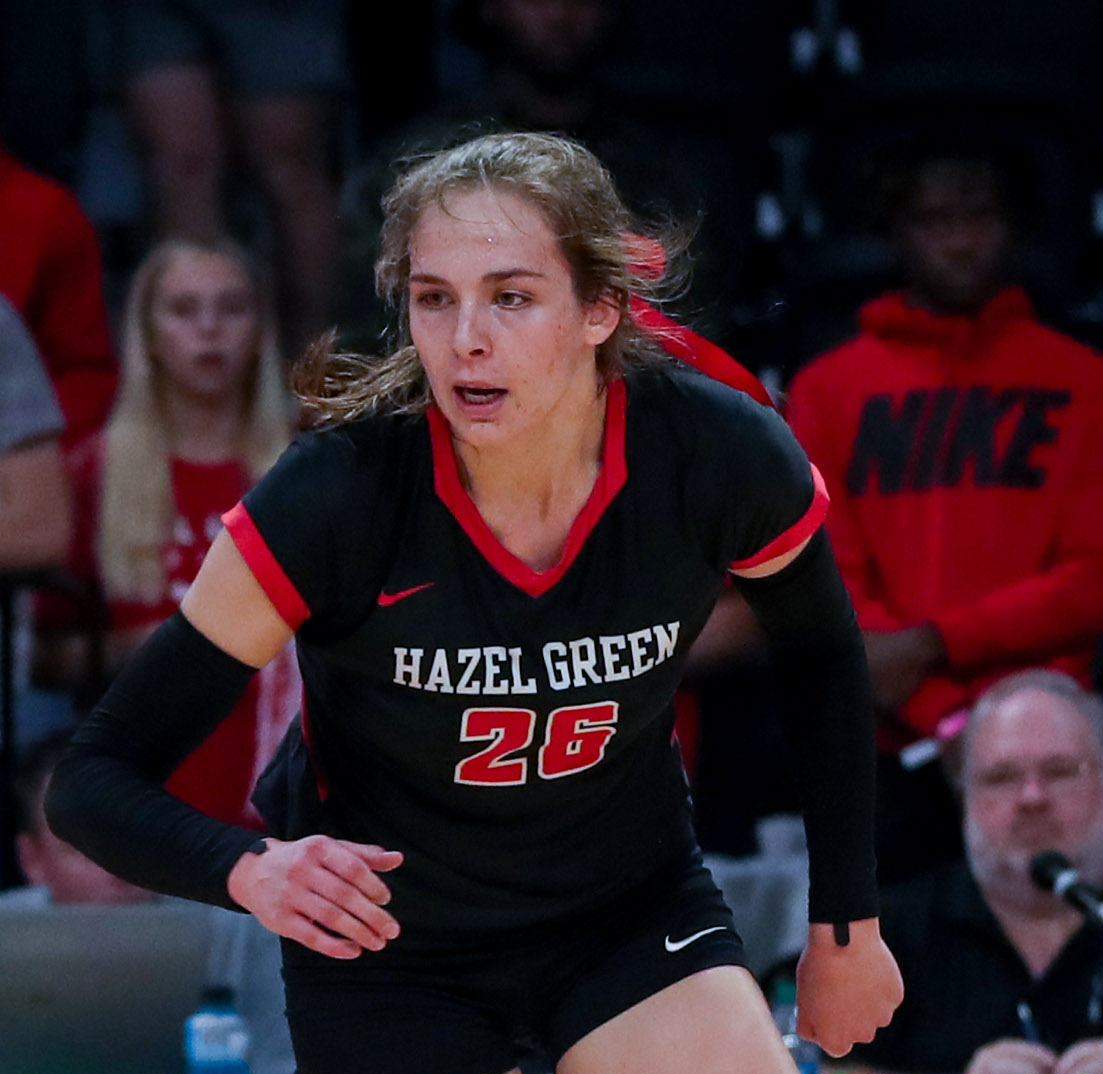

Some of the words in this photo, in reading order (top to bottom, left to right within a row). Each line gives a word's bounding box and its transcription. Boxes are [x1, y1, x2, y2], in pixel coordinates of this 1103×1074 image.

[847, 385, 1071, 495] NIKE
[394, 646, 537, 694] HAZEL
[543, 621, 680, 690] GREEN
[454, 701, 619, 786] 26
